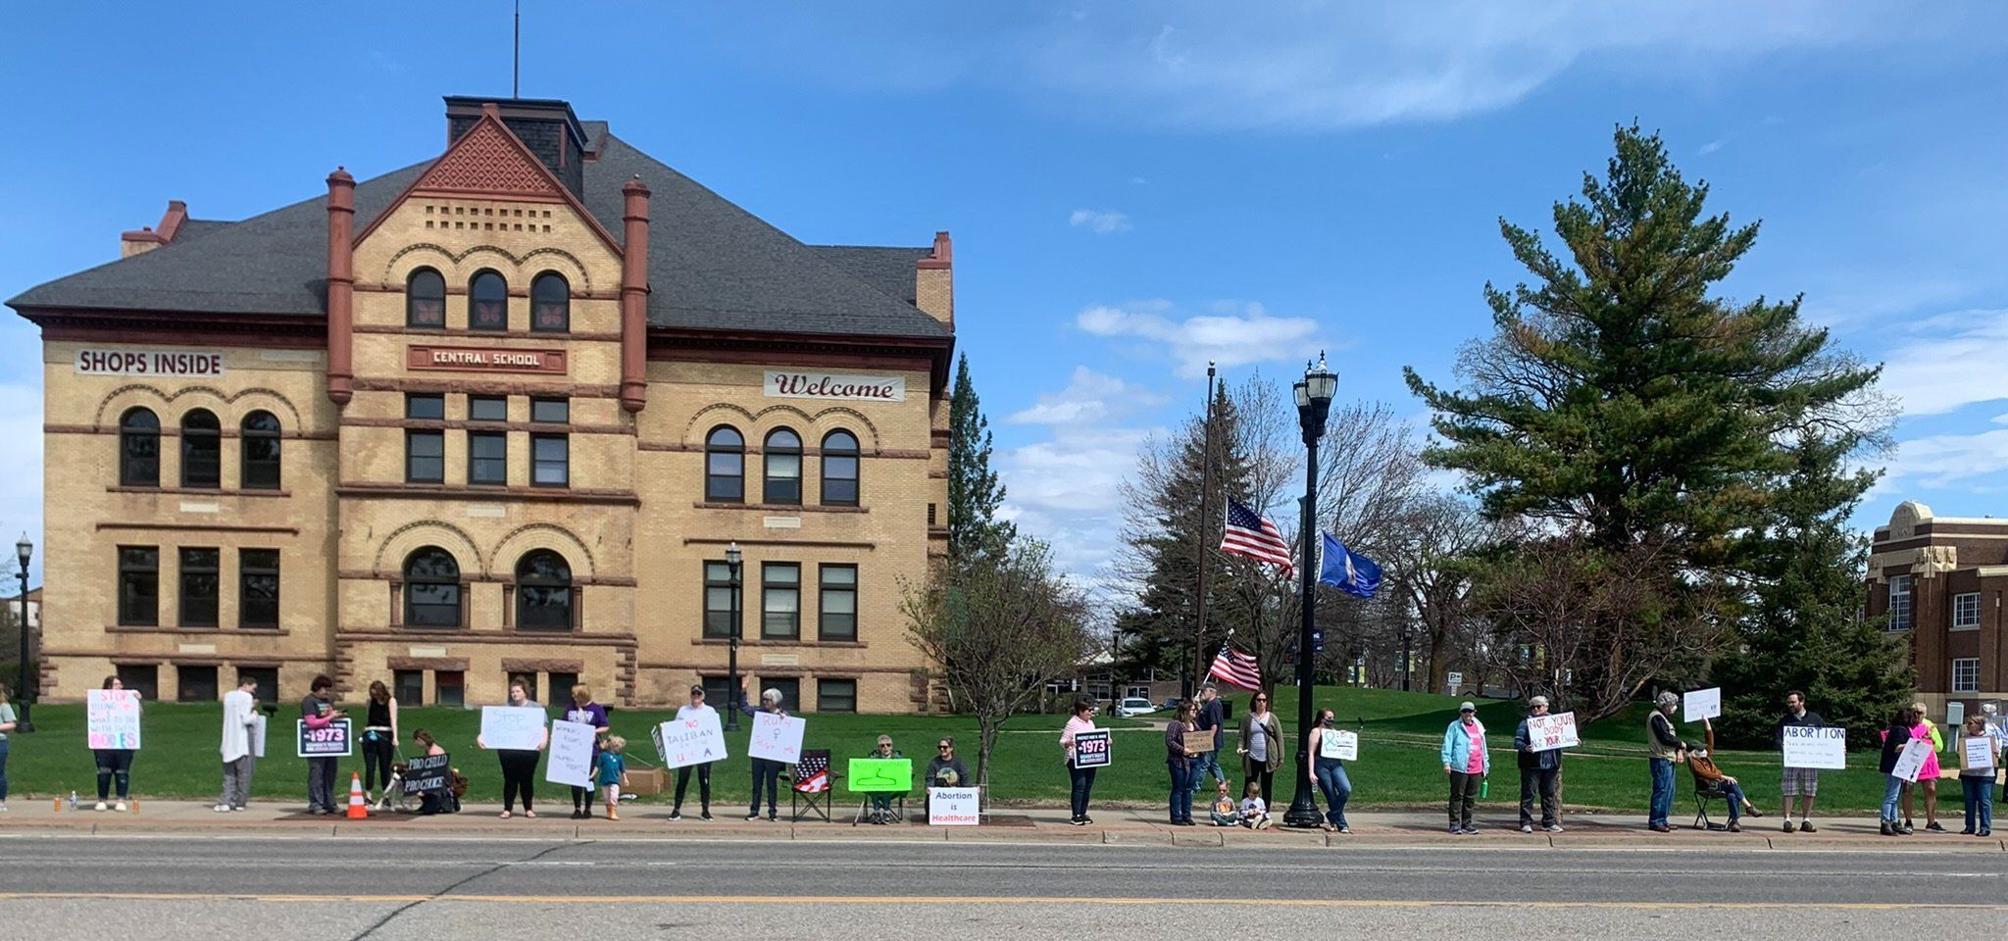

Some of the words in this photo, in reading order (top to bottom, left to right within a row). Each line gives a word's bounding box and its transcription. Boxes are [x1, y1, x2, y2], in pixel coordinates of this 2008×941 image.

[80, 351, 147, 373] SHOPS
[154, 354, 220, 374] INSIDE
[434, 352, 488, 364] CENTRAL
[493, 353, 540, 366] SCHOOL
[775, 374, 894, 398] Welcome
[686, 720, 699, 729] NO
[1530, 718, 1546, 729] NOT
[1551, 714, 1575, 728] YOUR
[667, 729, 713, 744] TALIBAN
[1543, 726, 1564, 735] BODY
[1785, 727, 1844, 739] ABORTION
[936, 792, 973, 800] Abortion
[951, 803, 957, 811] is
[932, 815, 976, 823] Healthcare
